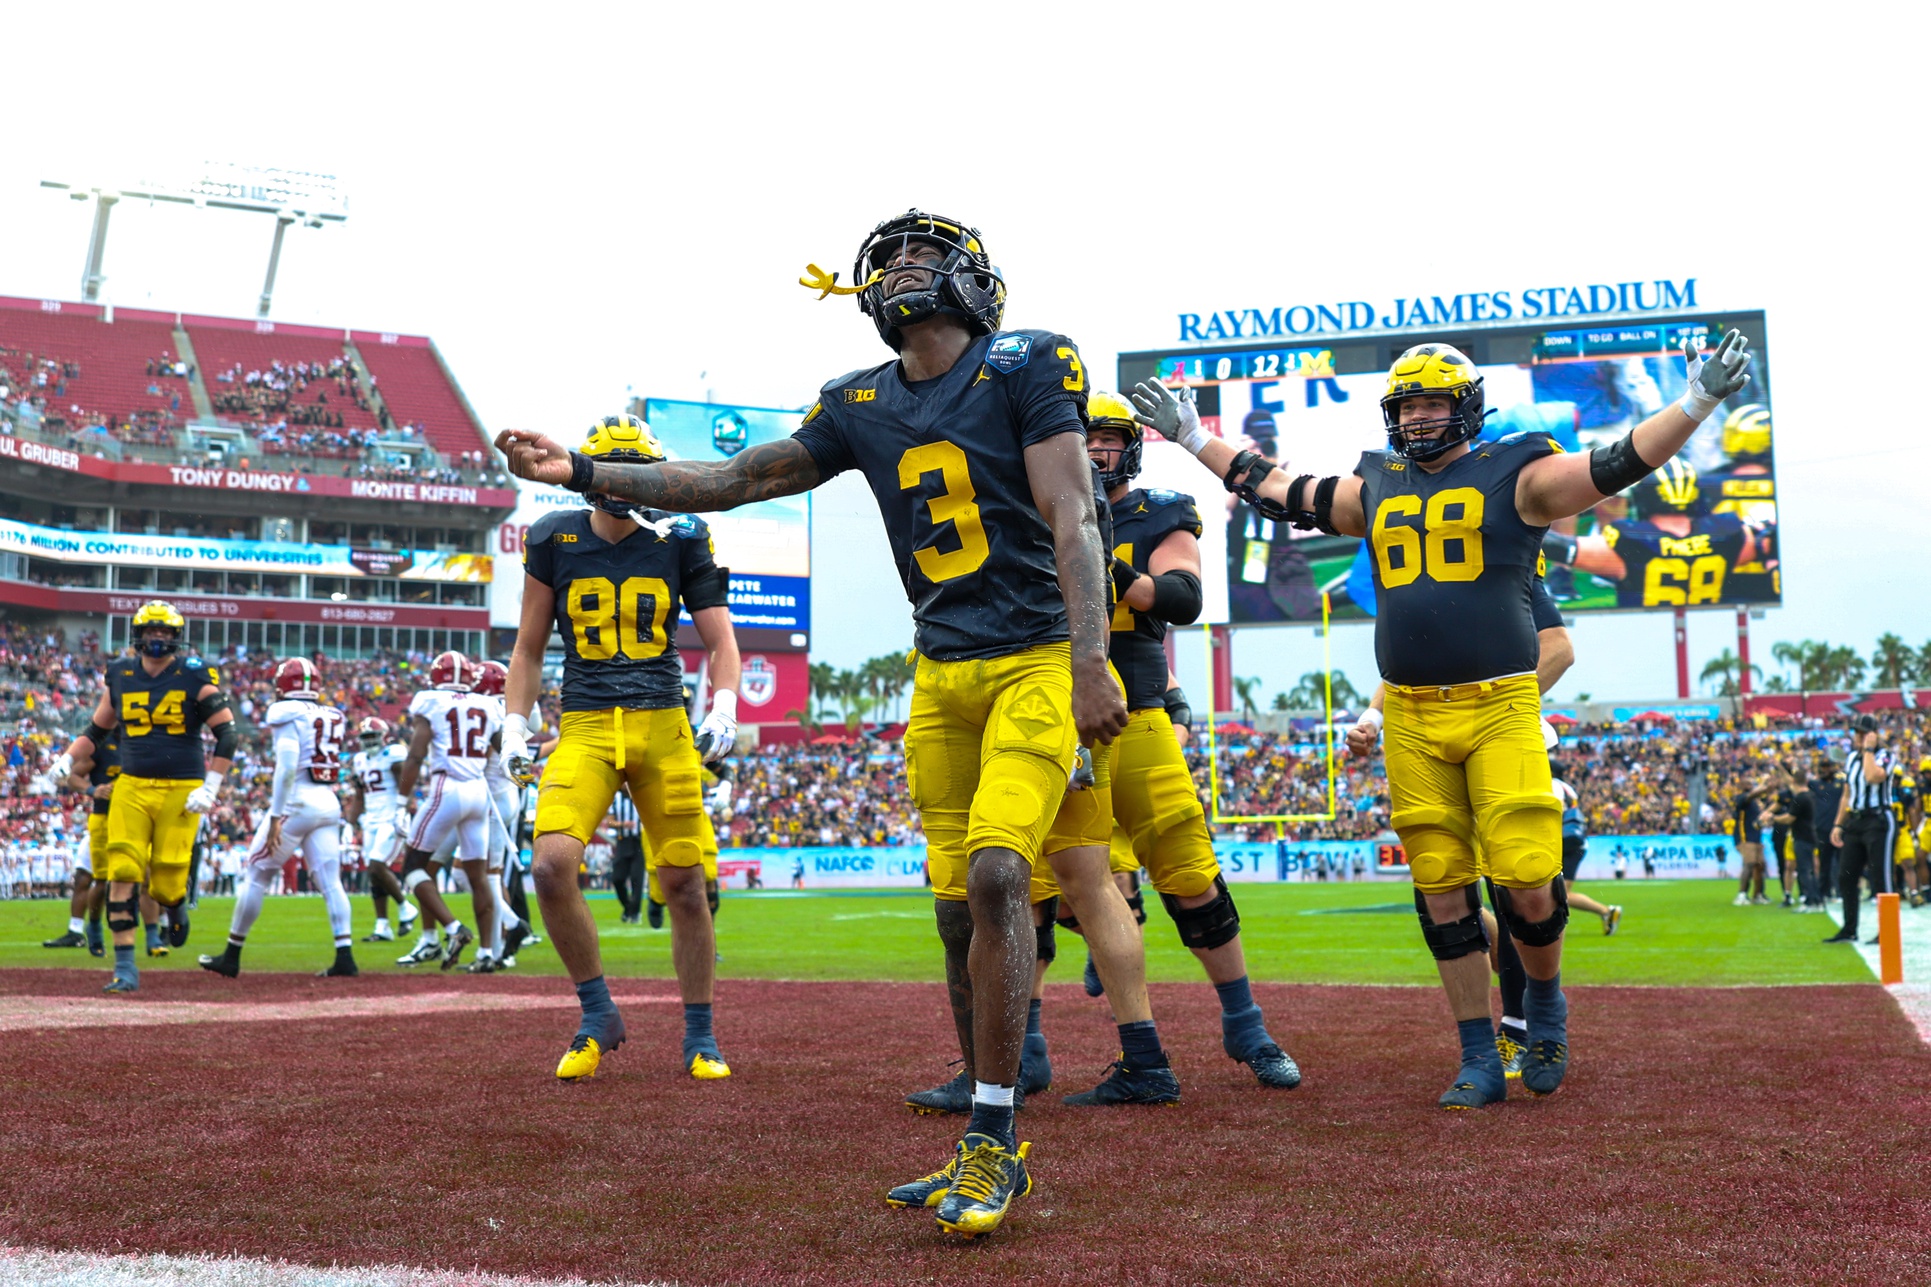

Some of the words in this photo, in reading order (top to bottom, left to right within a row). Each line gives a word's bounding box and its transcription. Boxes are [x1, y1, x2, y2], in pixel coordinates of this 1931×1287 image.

[1178, 301, 1375, 341] RAYMOND
[1382, 290, 1512, 328] JAMES
[1522, 278, 1697, 318] STADIUM
[1543, 336, 1572, 346] DOWN
[1588, 334, 1599, 343] TO
[1601, 333, 1614, 343] GO
[1620, 331, 1642, 341] BALL
[1643, 330, 1657, 340] ON
[1056, 347, 1083, 391] 3
[1216, 357, 1232, 380] 0
[1252, 354, 1280, 377] 12
[1299, 350, 1333, 376] M
[20, 441, 79, 471] GRUBER
[170, 466, 222, 487] TONY
[226, 471, 294, 492] DUNGY
[351, 480, 416, 500] MONTE
[420, 486, 477, 504] KIFFIN
[535, 493, 586, 506] HYUND
[898, 440, 991, 583] 3
[30, 535, 80, 554] MILLION
[85, 541, 193, 558] CONTRIBUTED
[199, 547, 219, 560] TO
[225, 549, 323, 565] UNIVERSITIES
[1372, 487, 1485, 589] 68
[728, 579, 761, 592] PETE
[109, 597, 140, 610] TEXT
[220, 602, 239, 615] TO
[727, 593, 796, 607] EARWATER
[567, 576, 671, 660] 80
[121, 690, 186, 737] 54
[311, 717, 343, 764] 15
[446, 707, 487, 758] 12
[1632, 846, 1688, 860] TMPA
